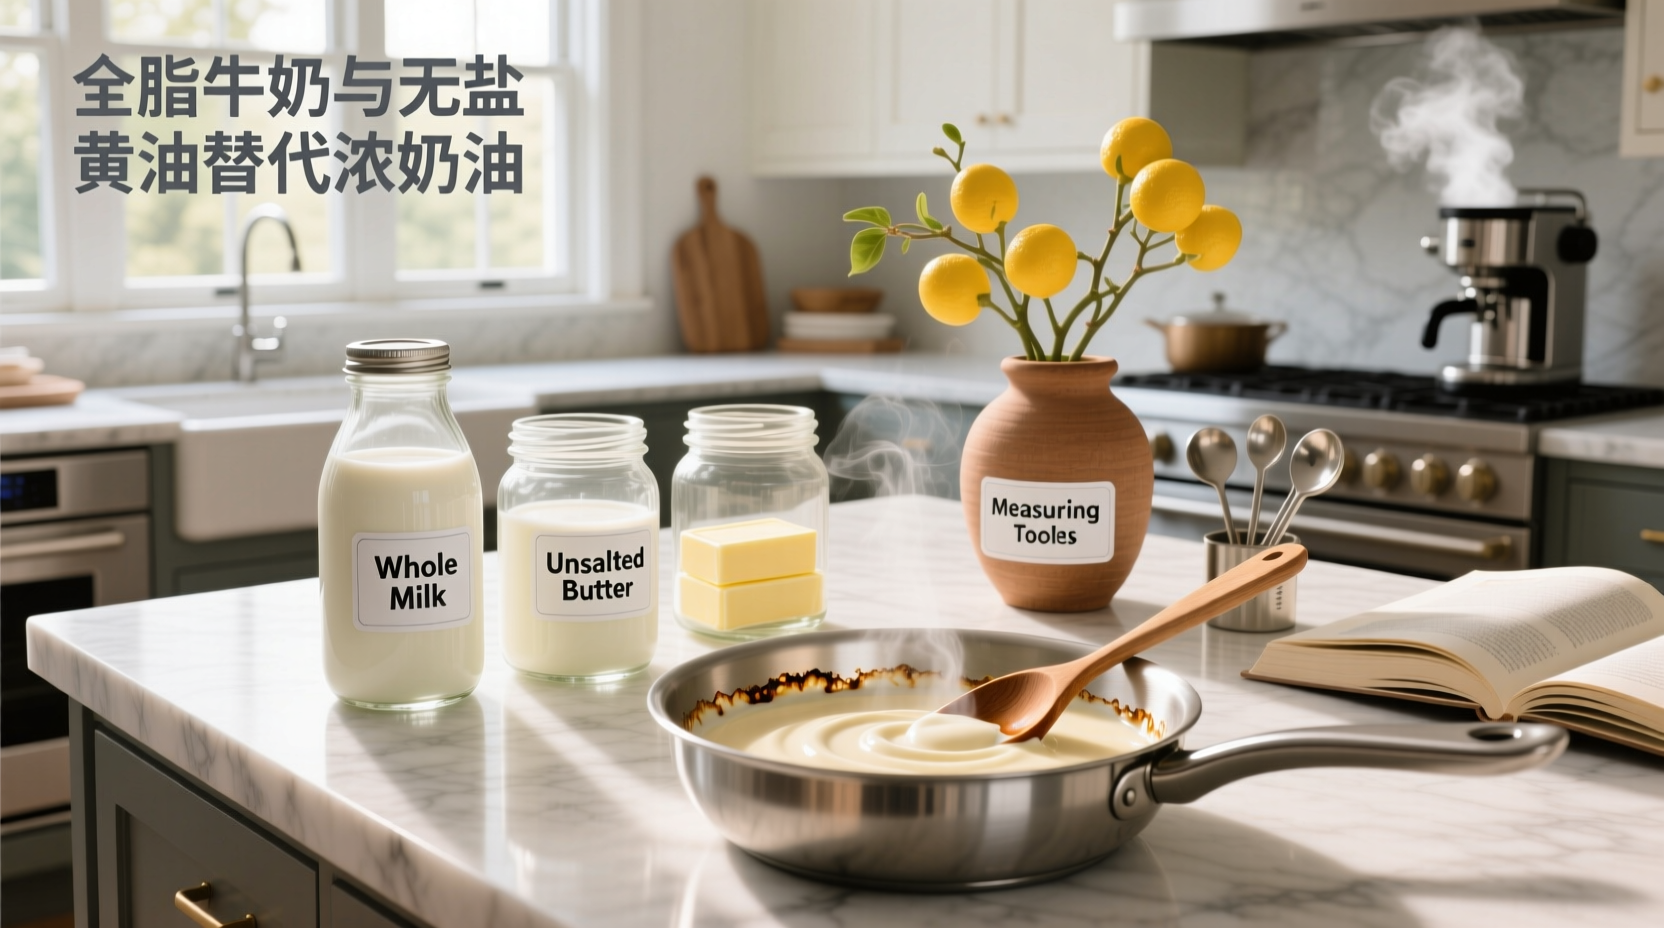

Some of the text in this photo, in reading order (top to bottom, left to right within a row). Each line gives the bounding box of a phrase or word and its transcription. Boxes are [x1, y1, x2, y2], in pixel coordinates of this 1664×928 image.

[992, 497, 1100, 525] Measuring
[1013, 523, 1077, 545] Tooles
[374, 551, 458, 580] Whole
[546, 545, 645, 575] Unsalted
[390, 582, 447, 611] Milk
[562, 579, 634, 601] Butter
